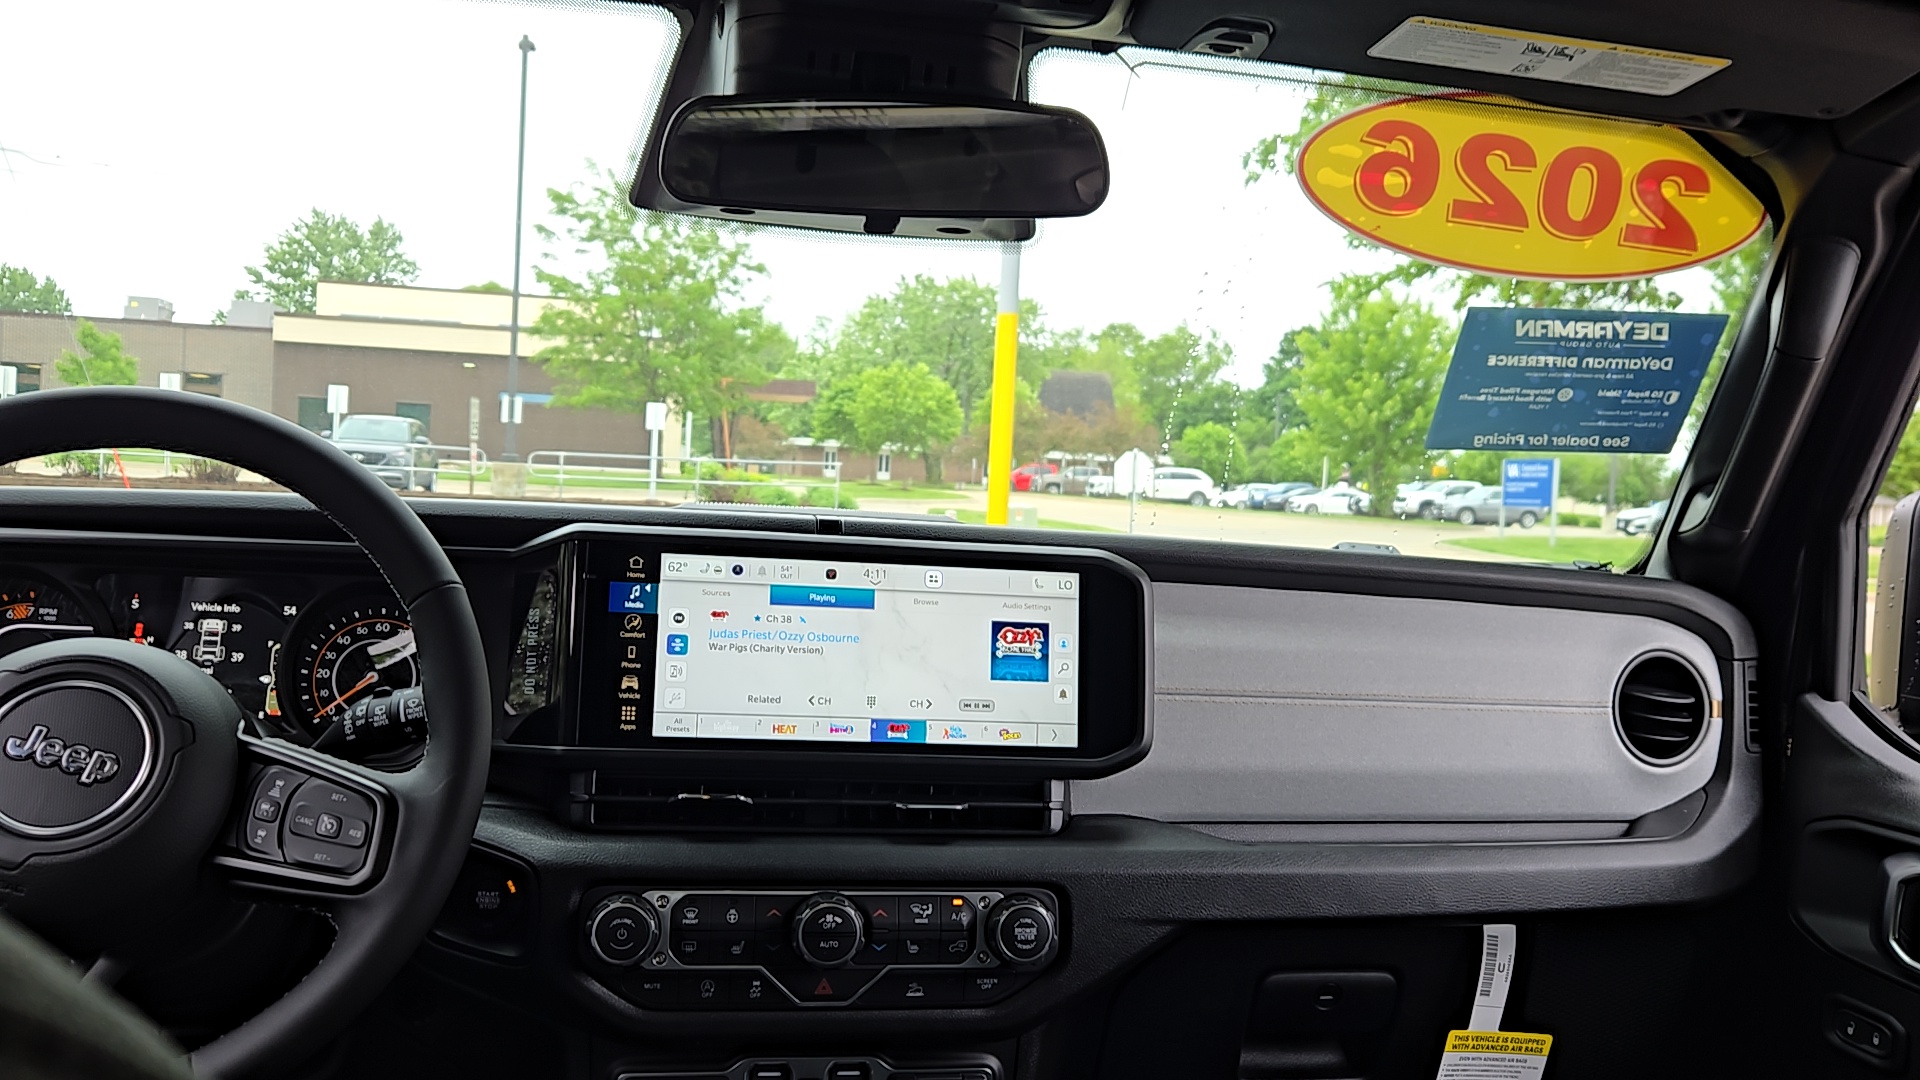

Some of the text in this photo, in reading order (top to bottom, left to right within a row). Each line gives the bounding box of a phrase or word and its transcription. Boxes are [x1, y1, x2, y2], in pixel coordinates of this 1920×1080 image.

[626, 571, 646, 579] Home
[863, 568, 887, 579] 4:11
[1059, 580, 1073, 590] LO
[701, 588, 731, 597] Sources
[809, 592, 836, 603] Playing
[913, 598, 939, 606] Browse
[190, 602, 241, 614] Vehicle Info
[624, 601, 645, 609] Media
[1002, 602, 1052, 612] Audio Settings
[6, 608, 14, 619] 6
[27, 606, 36, 617] 7
[38, 607, 58, 615] RPM
[283, 605, 297, 616] 54
[766, 614, 792, 623] Ch 38
[183, 622, 195, 630] 38
[231, 624, 243, 632] 39
[375, 623, 391, 632] 60
[356, 627, 369, 635] 50
[620, 631, 646, 639] Comfort
[709, 628, 860, 643] Judas Priest/Ozzy Osbourne
[336, 636, 351, 645] 40
[524, 607, 540, 695] DO NOT PRESS
[709, 643, 824, 656] War Pigs (Charity Version)
[230, 652, 245, 663] 39
[325, 651, 337, 660] 30
[316, 669, 331, 678] 20
[320, 689, 329, 697] 10
[747, 694, 781, 704] Related
[817, 697, 832, 705] CH
[405, 705, 423, 713] FRONT
[910, 700, 924, 709] CH
[327, 706, 336, 716] 0
[407, 710, 424, 719] WIPER
[355, 718, 366, 727] OFF
[373, 719, 390, 728] WIPER
[620, 723, 637, 731] Apps
[772, 724, 798, 734] HEAT
[5, 724, 121, 786] Jeep
[295, 815, 315, 826] CANC
[348, 828, 362, 838] RES
[951, 912, 967, 921] A/C
[822, 921, 836, 929] OFF
[819, 940, 839, 948] AUTO
[1471, 1035, 1500, 1044] VEHICLE
[1510, 1037, 1547, 1046] EQUIPPED
[1470, 1044, 1510, 1052] ADVANCED
[1524, 1046, 1544, 1054] BAGS
